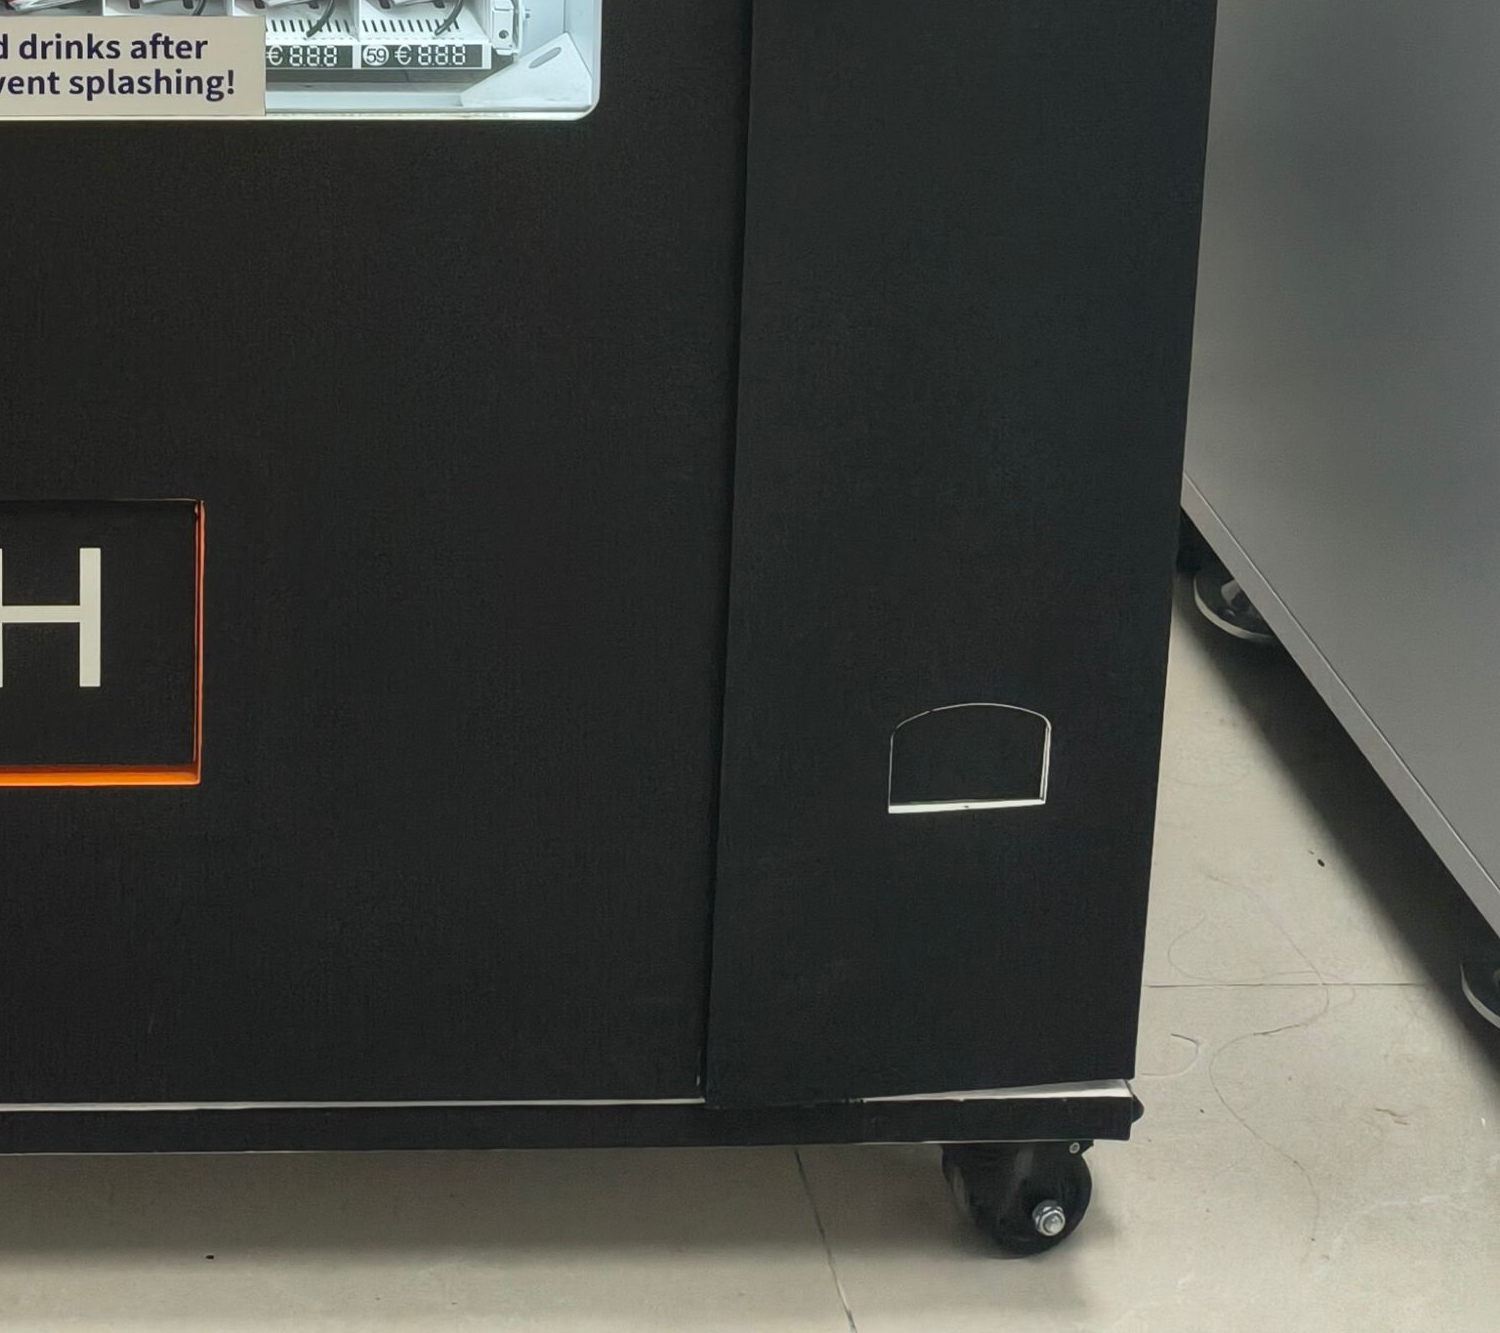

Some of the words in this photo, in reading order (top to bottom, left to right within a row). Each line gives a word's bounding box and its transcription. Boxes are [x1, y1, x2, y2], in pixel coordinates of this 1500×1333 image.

[19, 33, 120, 59] drinks
[131, 33, 208, 59] after
[366, 48, 386, 63] 59
[69, 69, 234, 102] splashing!
